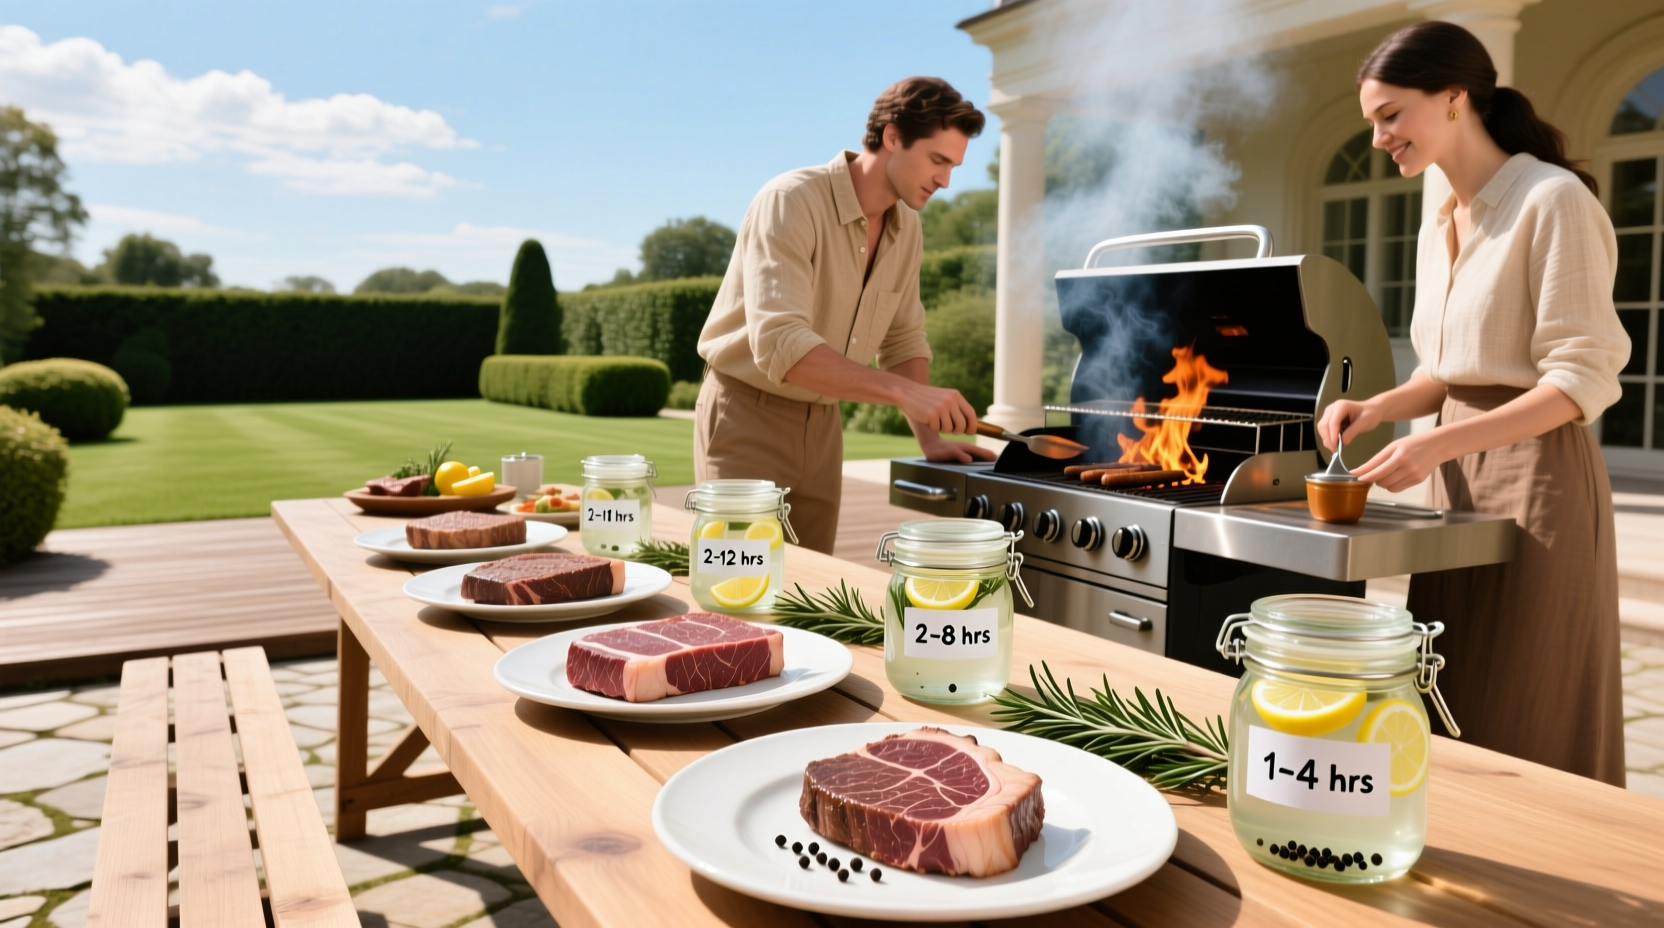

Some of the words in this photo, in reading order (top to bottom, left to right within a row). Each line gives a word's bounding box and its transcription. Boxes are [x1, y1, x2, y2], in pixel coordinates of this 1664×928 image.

[615, 509, 635, 523] hrs
[703, 549, 737, 566] 2-12
[741, 550, 765, 567] hrs
[915, 623, 956, 646] 2-8
[961, 625, 992, 645] hrs
[1263, 751, 1319, 790] 1-4
[1329, 763, 1374, 794] hrs
